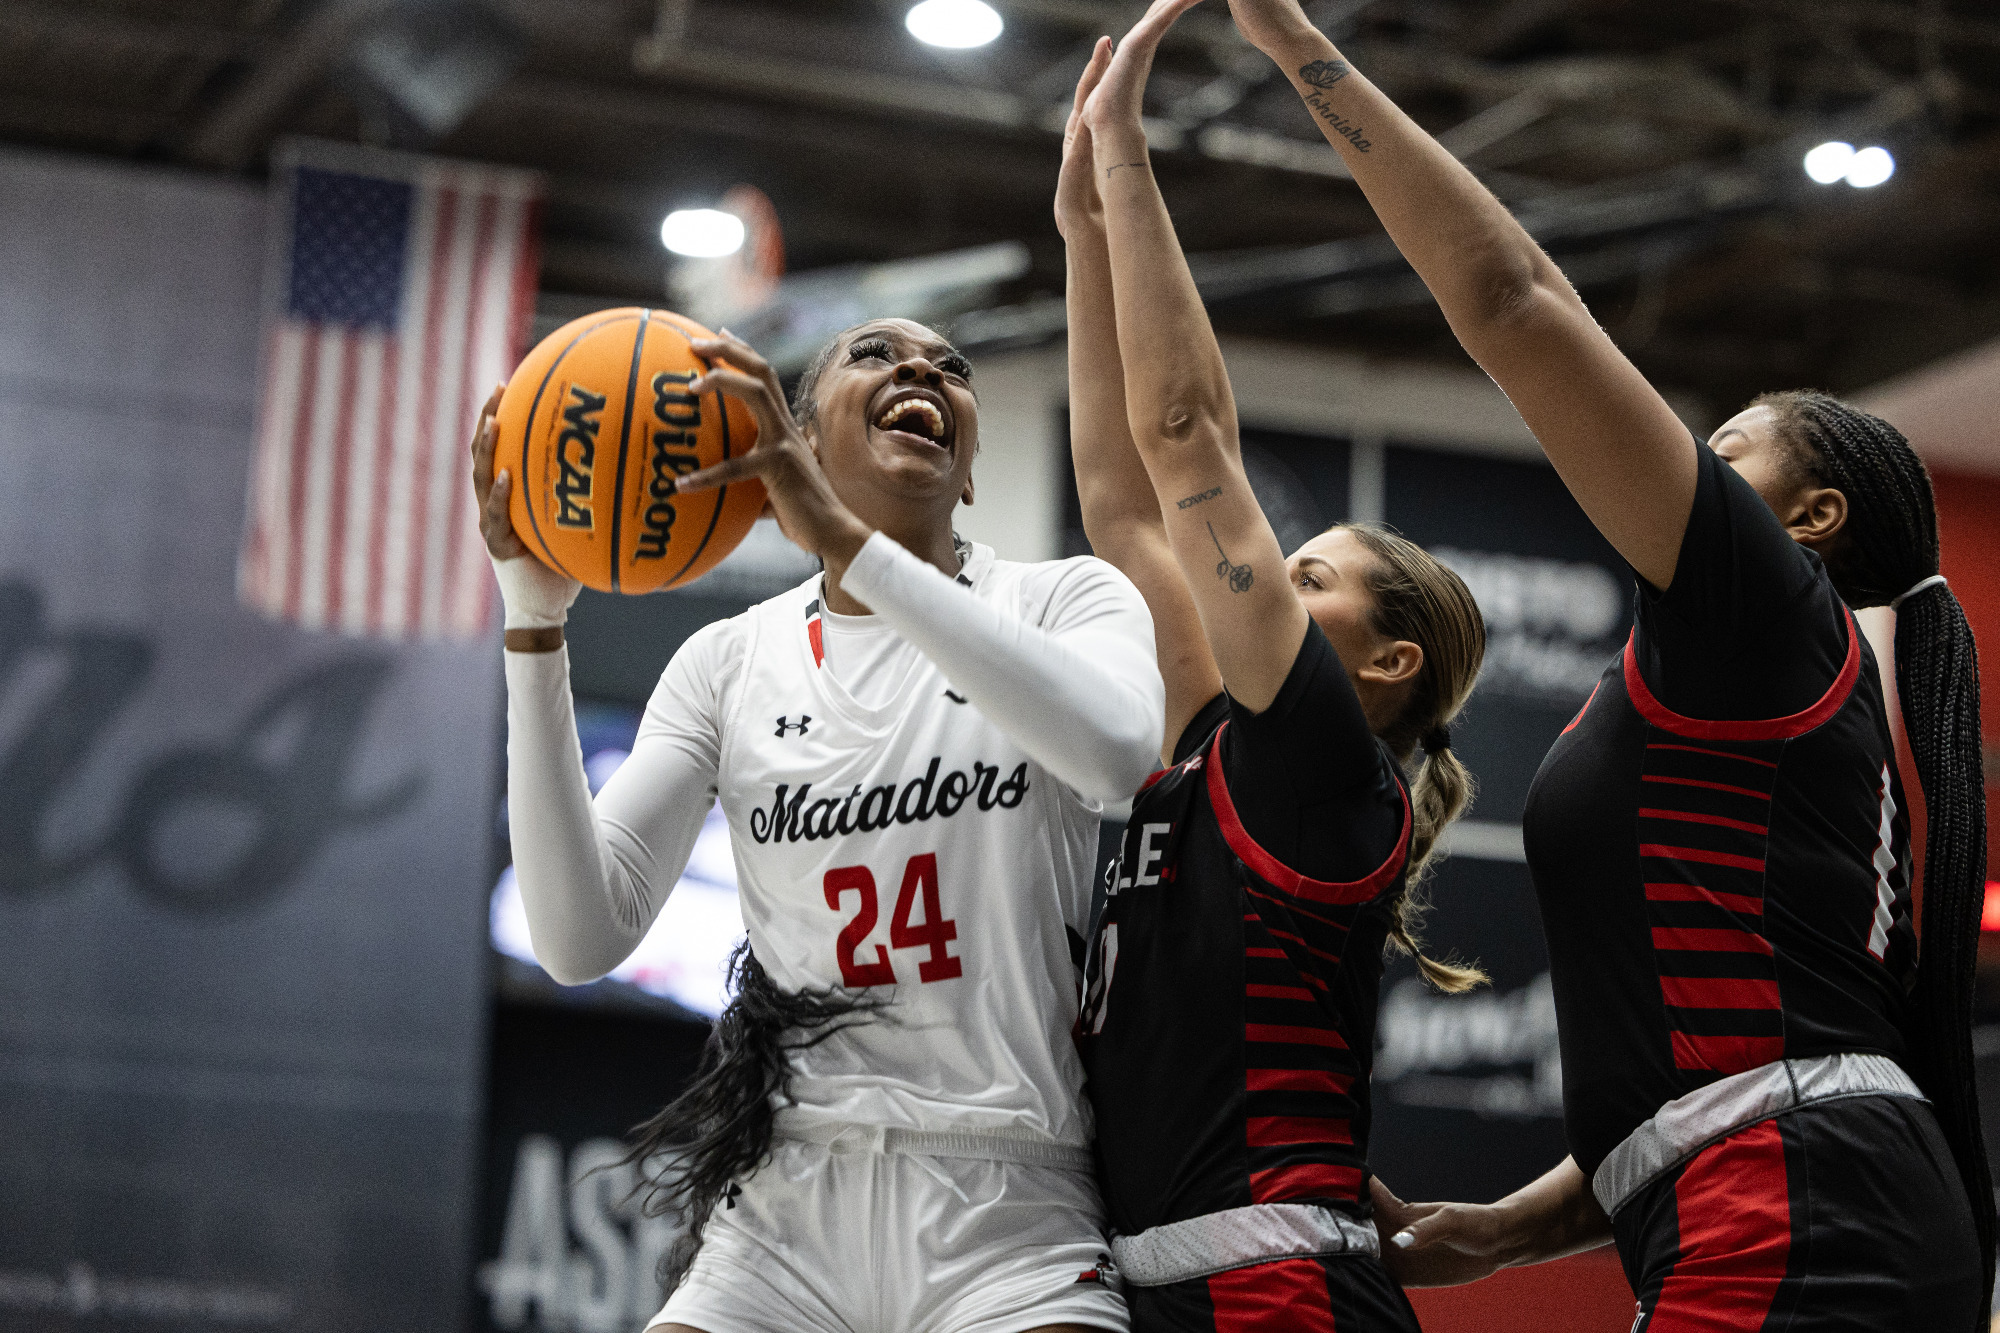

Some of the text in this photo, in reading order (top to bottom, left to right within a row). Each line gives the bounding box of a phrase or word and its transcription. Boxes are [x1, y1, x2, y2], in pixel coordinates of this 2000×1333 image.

[553, 382, 607, 532] NCAA
[633, 369, 701, 561] Wilson
[750, 756, 1031, 844] Matadors
[823, 851, 963, 988] 24
